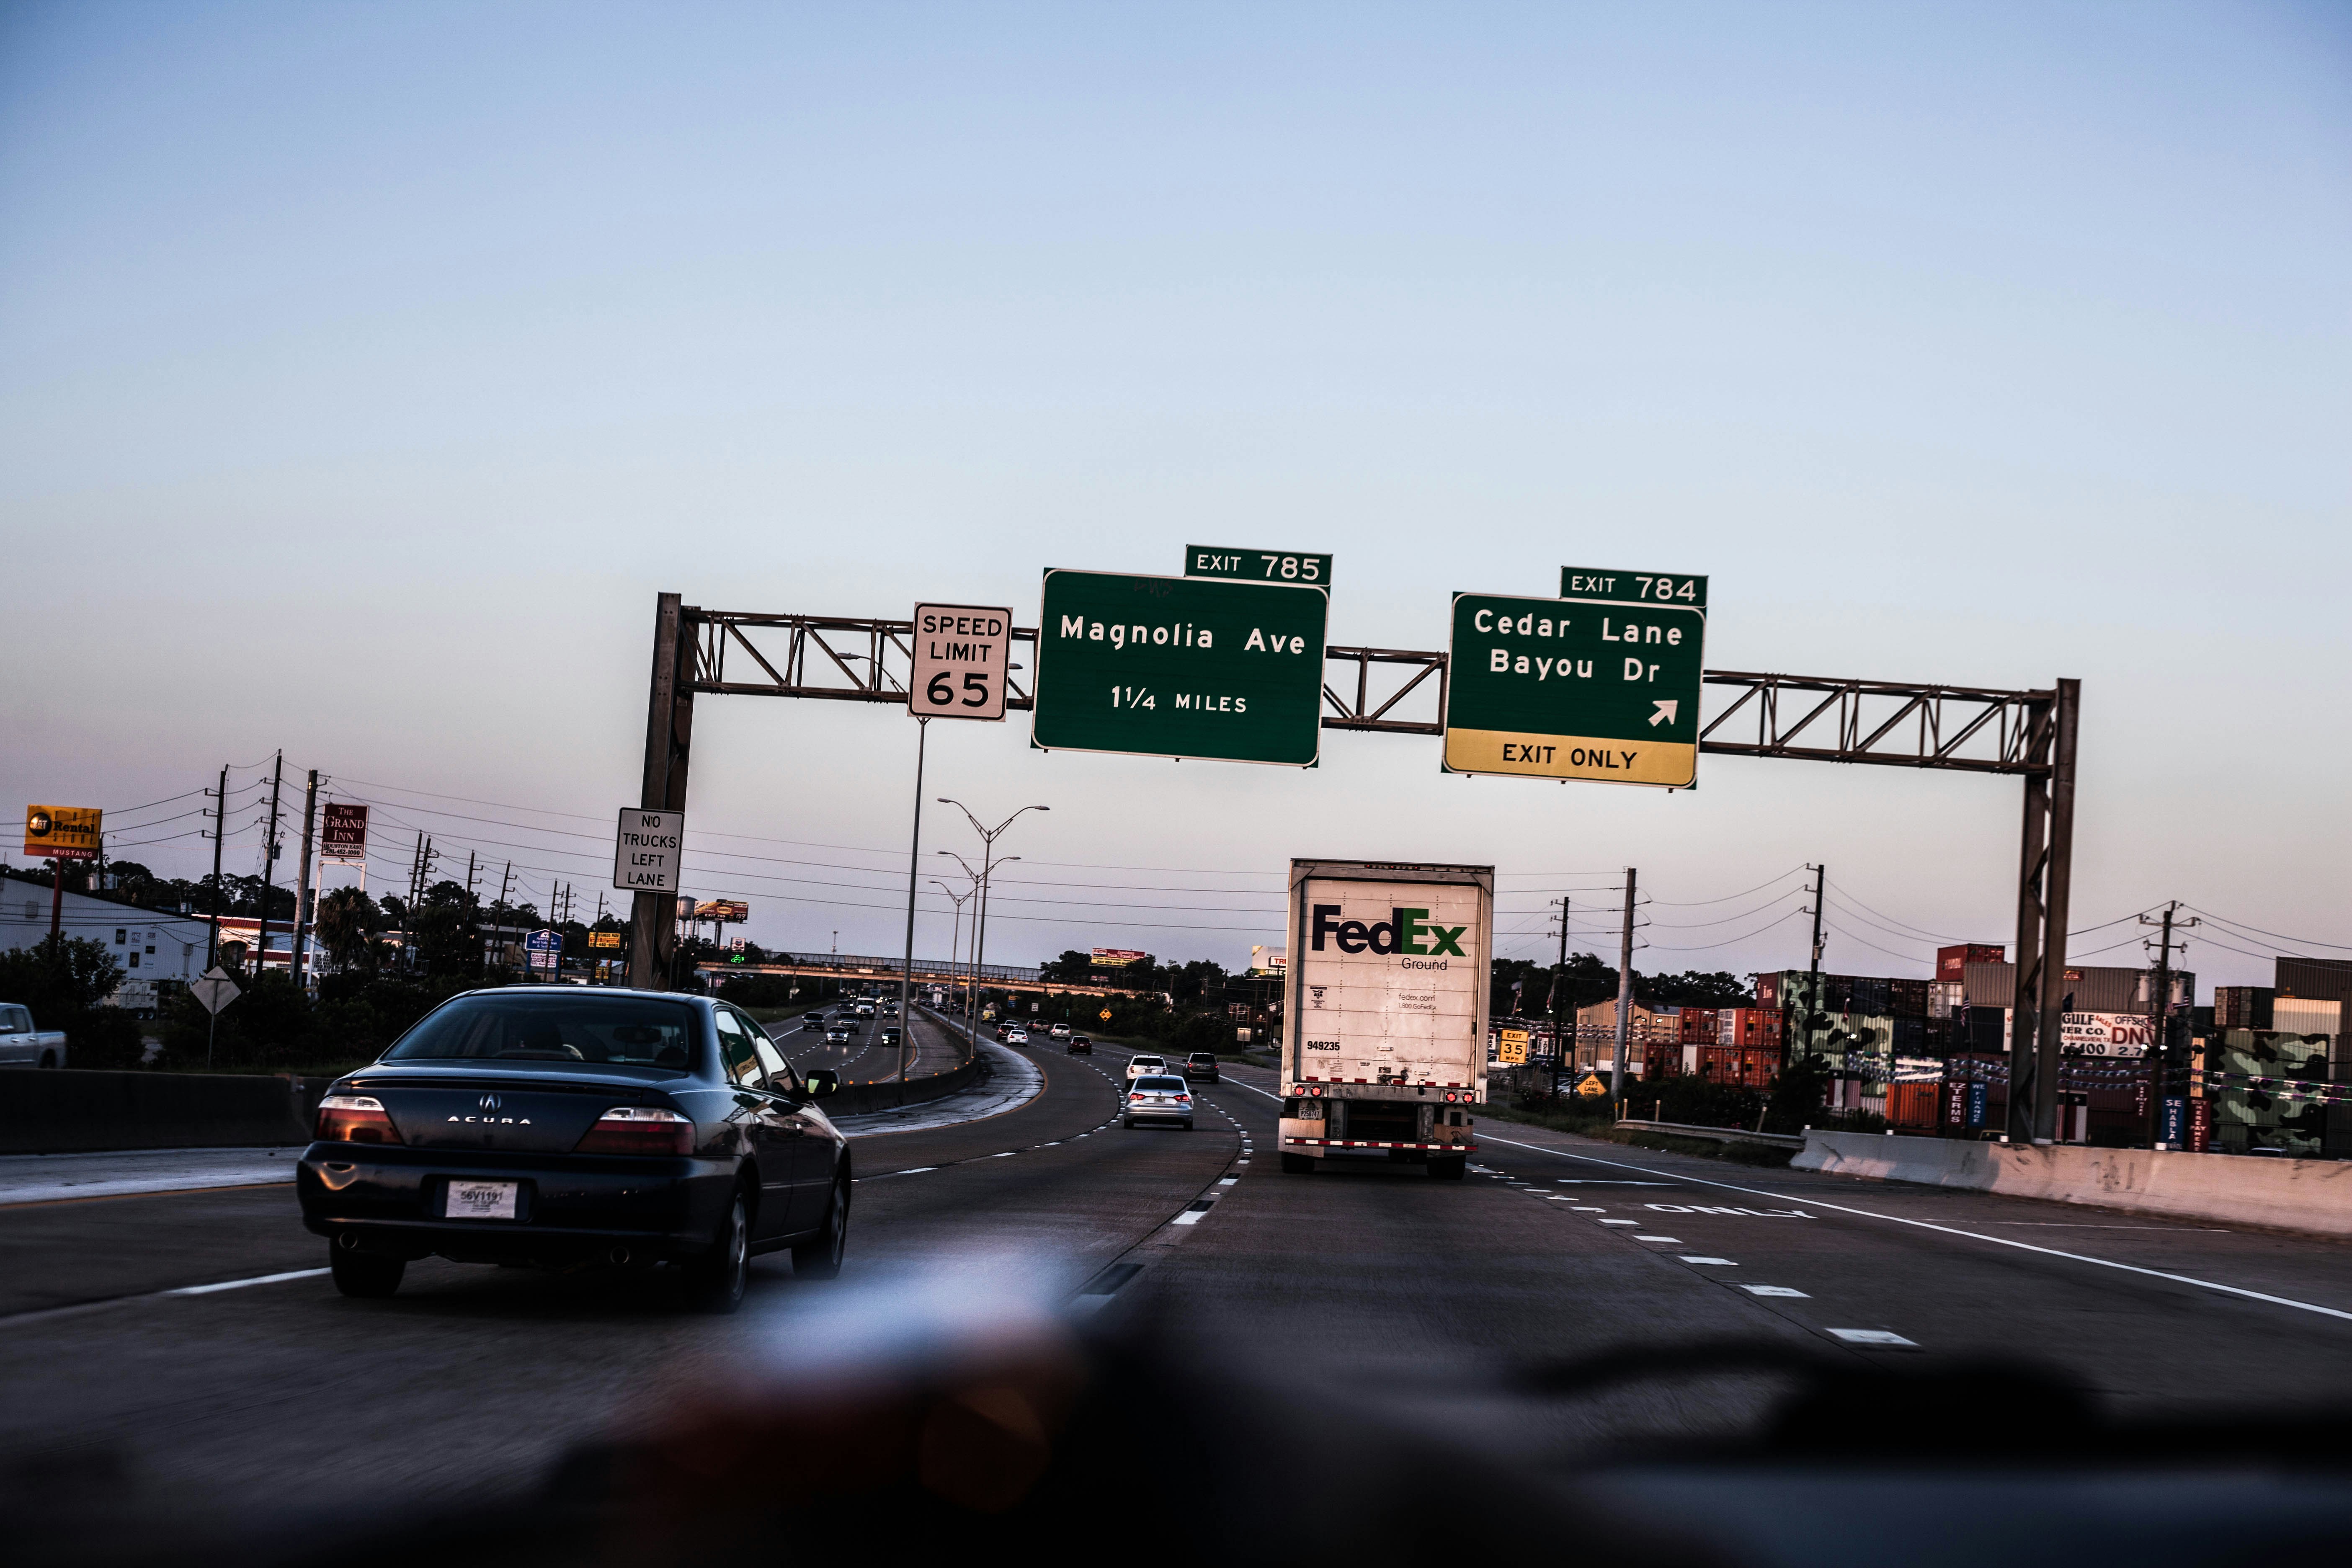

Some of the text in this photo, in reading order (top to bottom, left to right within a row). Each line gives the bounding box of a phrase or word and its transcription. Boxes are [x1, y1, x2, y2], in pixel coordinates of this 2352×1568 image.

[1197, 554, 1320, 580] EXIT 785
[1571, 575, 1697, 601] EXIT 784
[923, 615, 1002, 637] SPEED
[1474, 609, 1682, 645] Cedar Lane
[1060, 615, 1305, 654] Magnolia Ave
[930, 641, 992, 662] LIMIT
[1490, 648, 1660, 682] Bayou Dr
[927, 671, 989, 708] 65
[1175, 694, 1246, 713] MILES
[1502, 743, 1638, 769] EXIT ONLY
[339, 807, 353, 816] THE
[53, 821, 95, 833] Rental
[325, 816, 364, 829] GRAND
[641, 814, 661, 828] NO
[333, 830, 355, 841] INN
[623, 833, 677, 848] TRUCKS
[53, 849, 93, 857] MUSTANG
[632, 853, 665, 867] LEFT
[627, 872, 665, 887] LANE
[1311, 904, 1468, 957] FedEx
[1401, 957, 1447, 971] Ground
[1398, 993, 1435, 1001] fedex.com
[2062, 1013, 2094, 1025] GULF
[2115, 1016, 2156, 1025] OFFSHO
[1307, 1041, 1340, 1051] 949235
[1504, 1043, 1523, 1055] 35
[1951, 1088, 1963, 1123] TERMS
[1973, 1091, 1981, 1123] FINANCE
[2165, 1099, 2182, 1107] SE
[447, 1116, 532, 1125] ACURA
[2168, 1108, 2178, 1140] HABLA
[460, 1191, 504, 1201] 56V1191
[1643, 1204, 1819, 1219] ONLY
